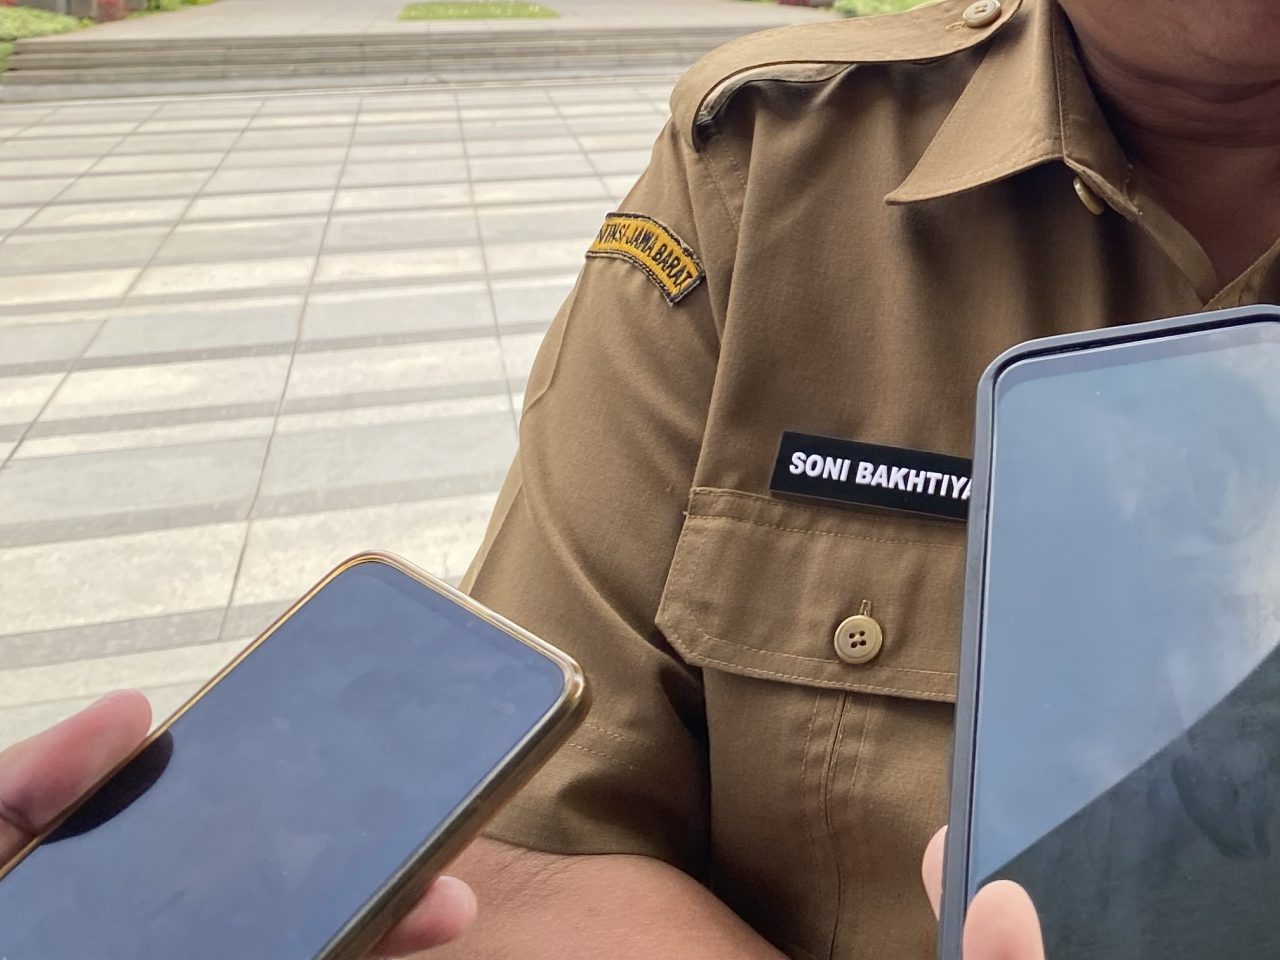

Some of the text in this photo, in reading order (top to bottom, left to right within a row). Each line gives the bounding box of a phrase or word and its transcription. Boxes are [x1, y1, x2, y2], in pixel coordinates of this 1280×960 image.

[626, 226, 659, 258] JAWA
[651, 243, 693, 288] BARAT
[789, 451, 851, 482] SONI
